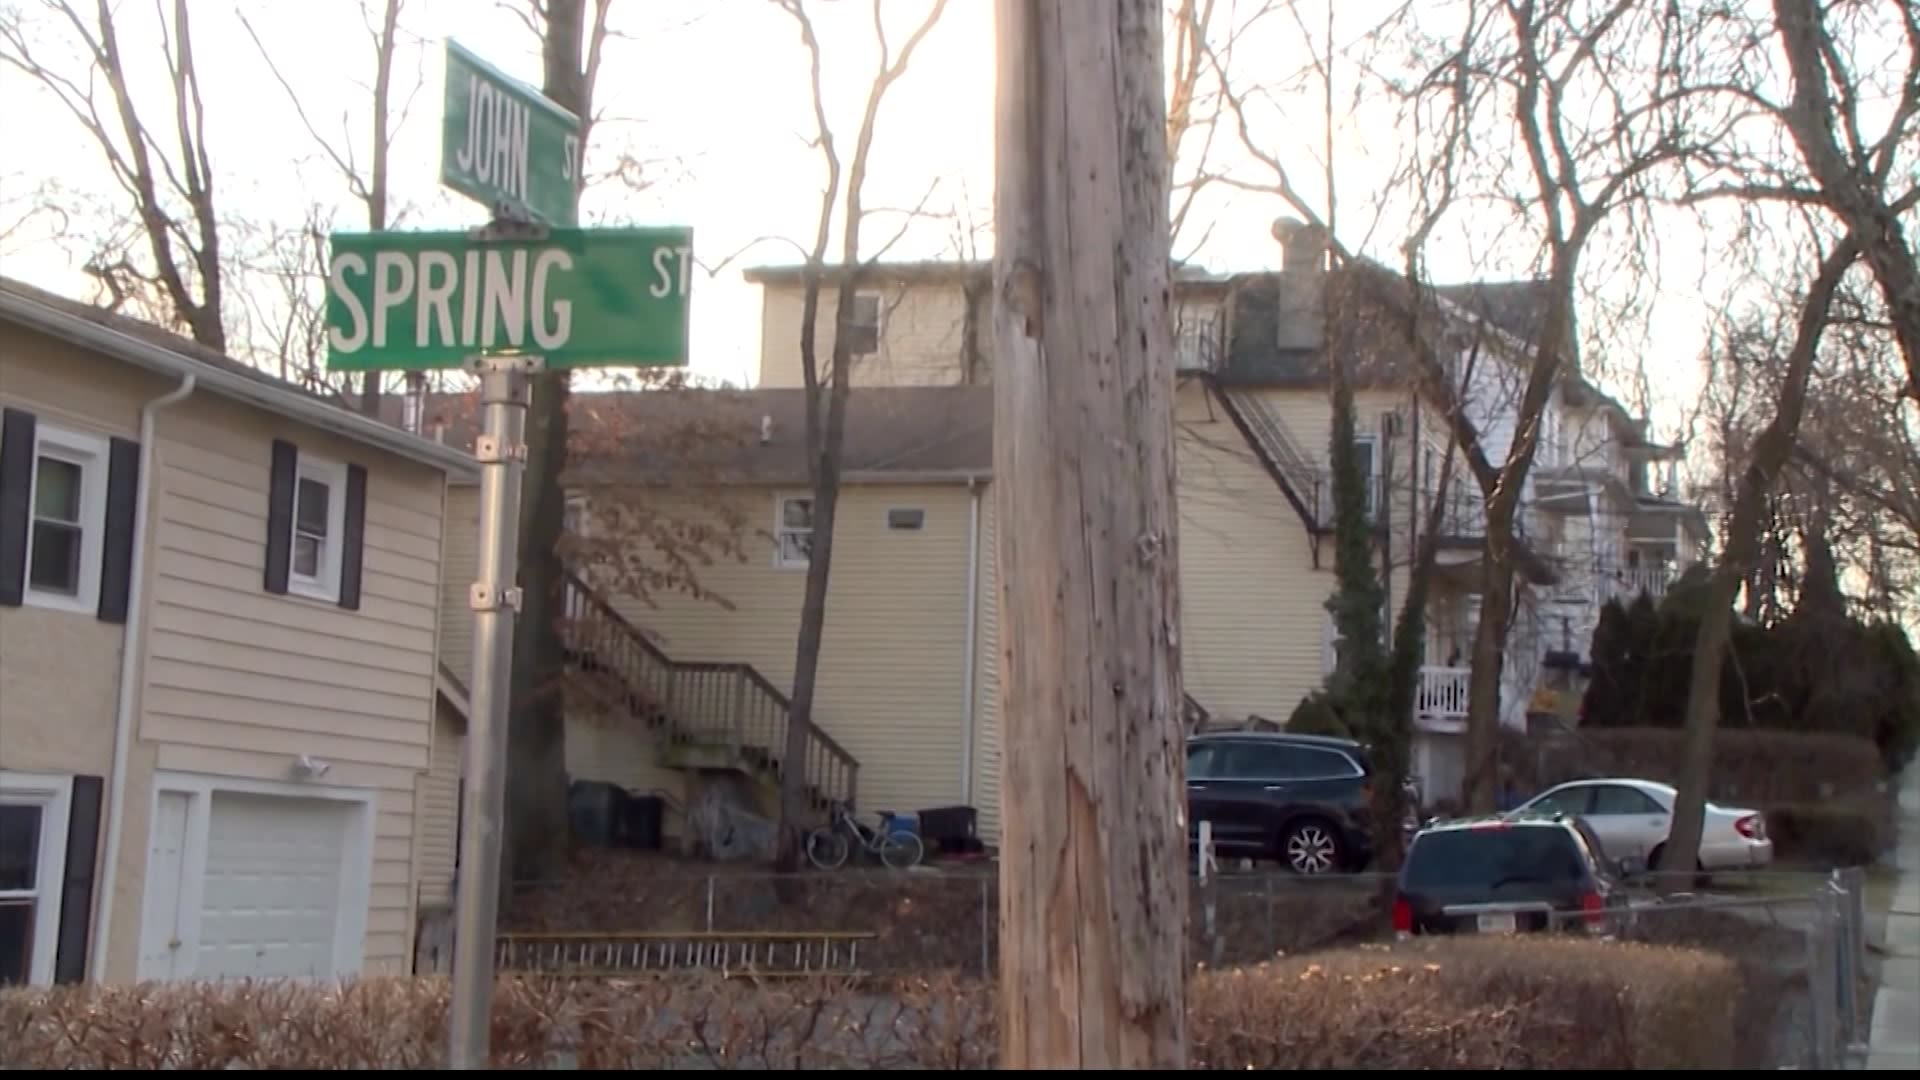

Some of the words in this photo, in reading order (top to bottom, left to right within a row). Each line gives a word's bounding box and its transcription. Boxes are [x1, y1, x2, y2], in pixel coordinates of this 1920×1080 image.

[457, 75, 529, 200] JOHN
[562, 134, 579, 182] ST
[329, 250, 573, 353] SPRING
[649, 247, 691, 298] ST
